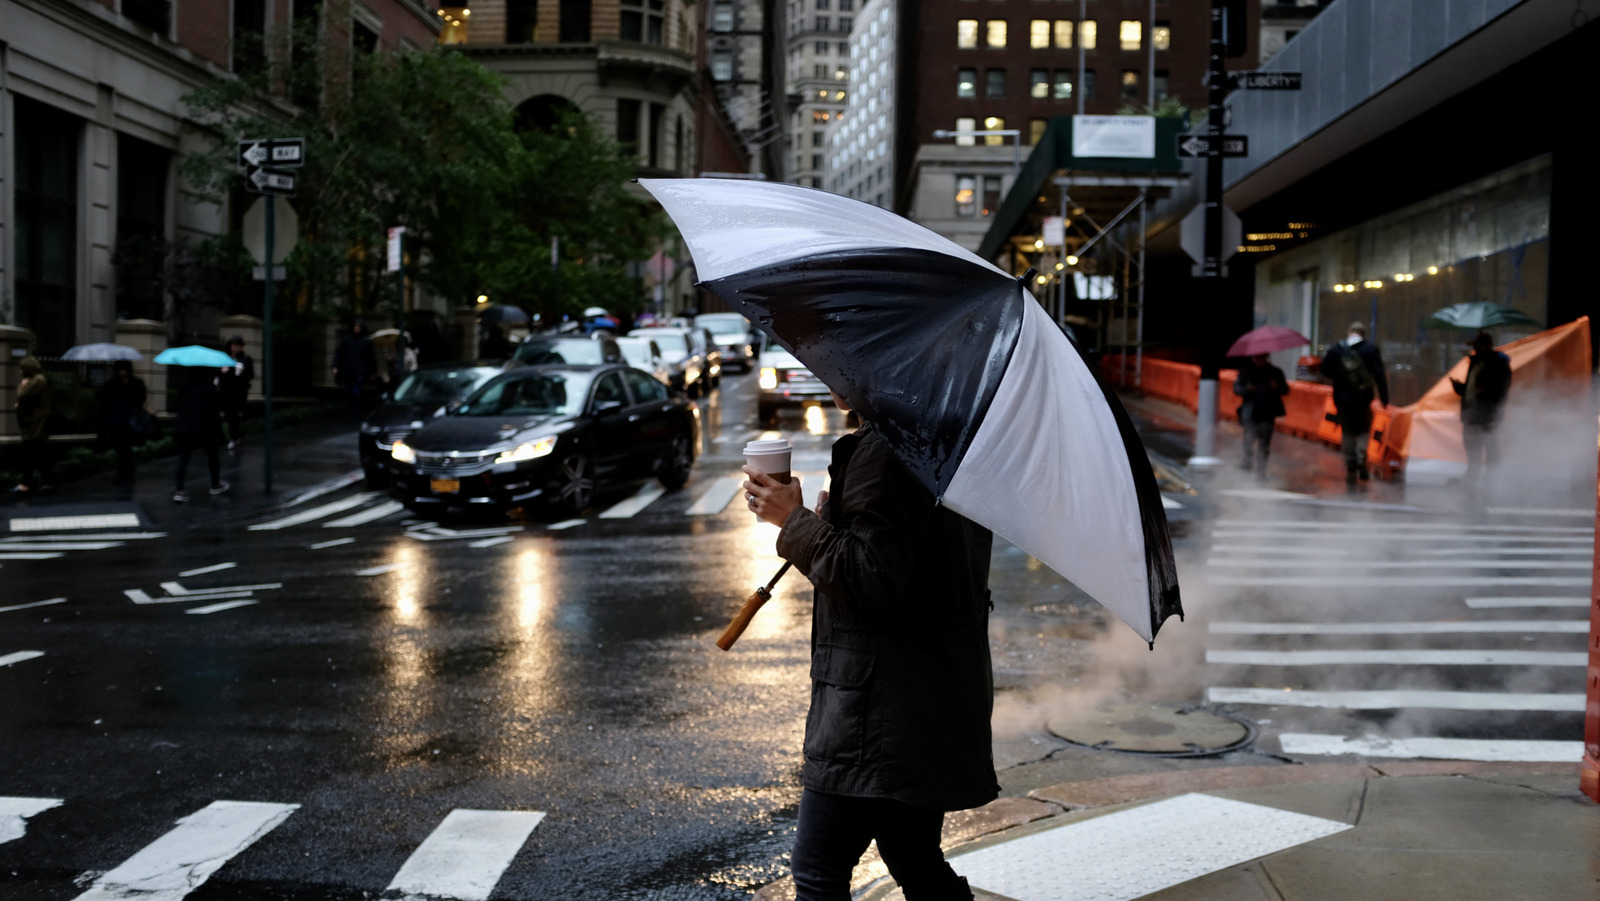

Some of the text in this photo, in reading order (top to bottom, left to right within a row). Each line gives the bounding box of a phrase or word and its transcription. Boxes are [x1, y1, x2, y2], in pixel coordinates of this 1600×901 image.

[1248, 75, 1291, 87] LIBERTY
[1189, 141, 1209, 151] ONE
[250, 148, 295, 159] ONE WAY
